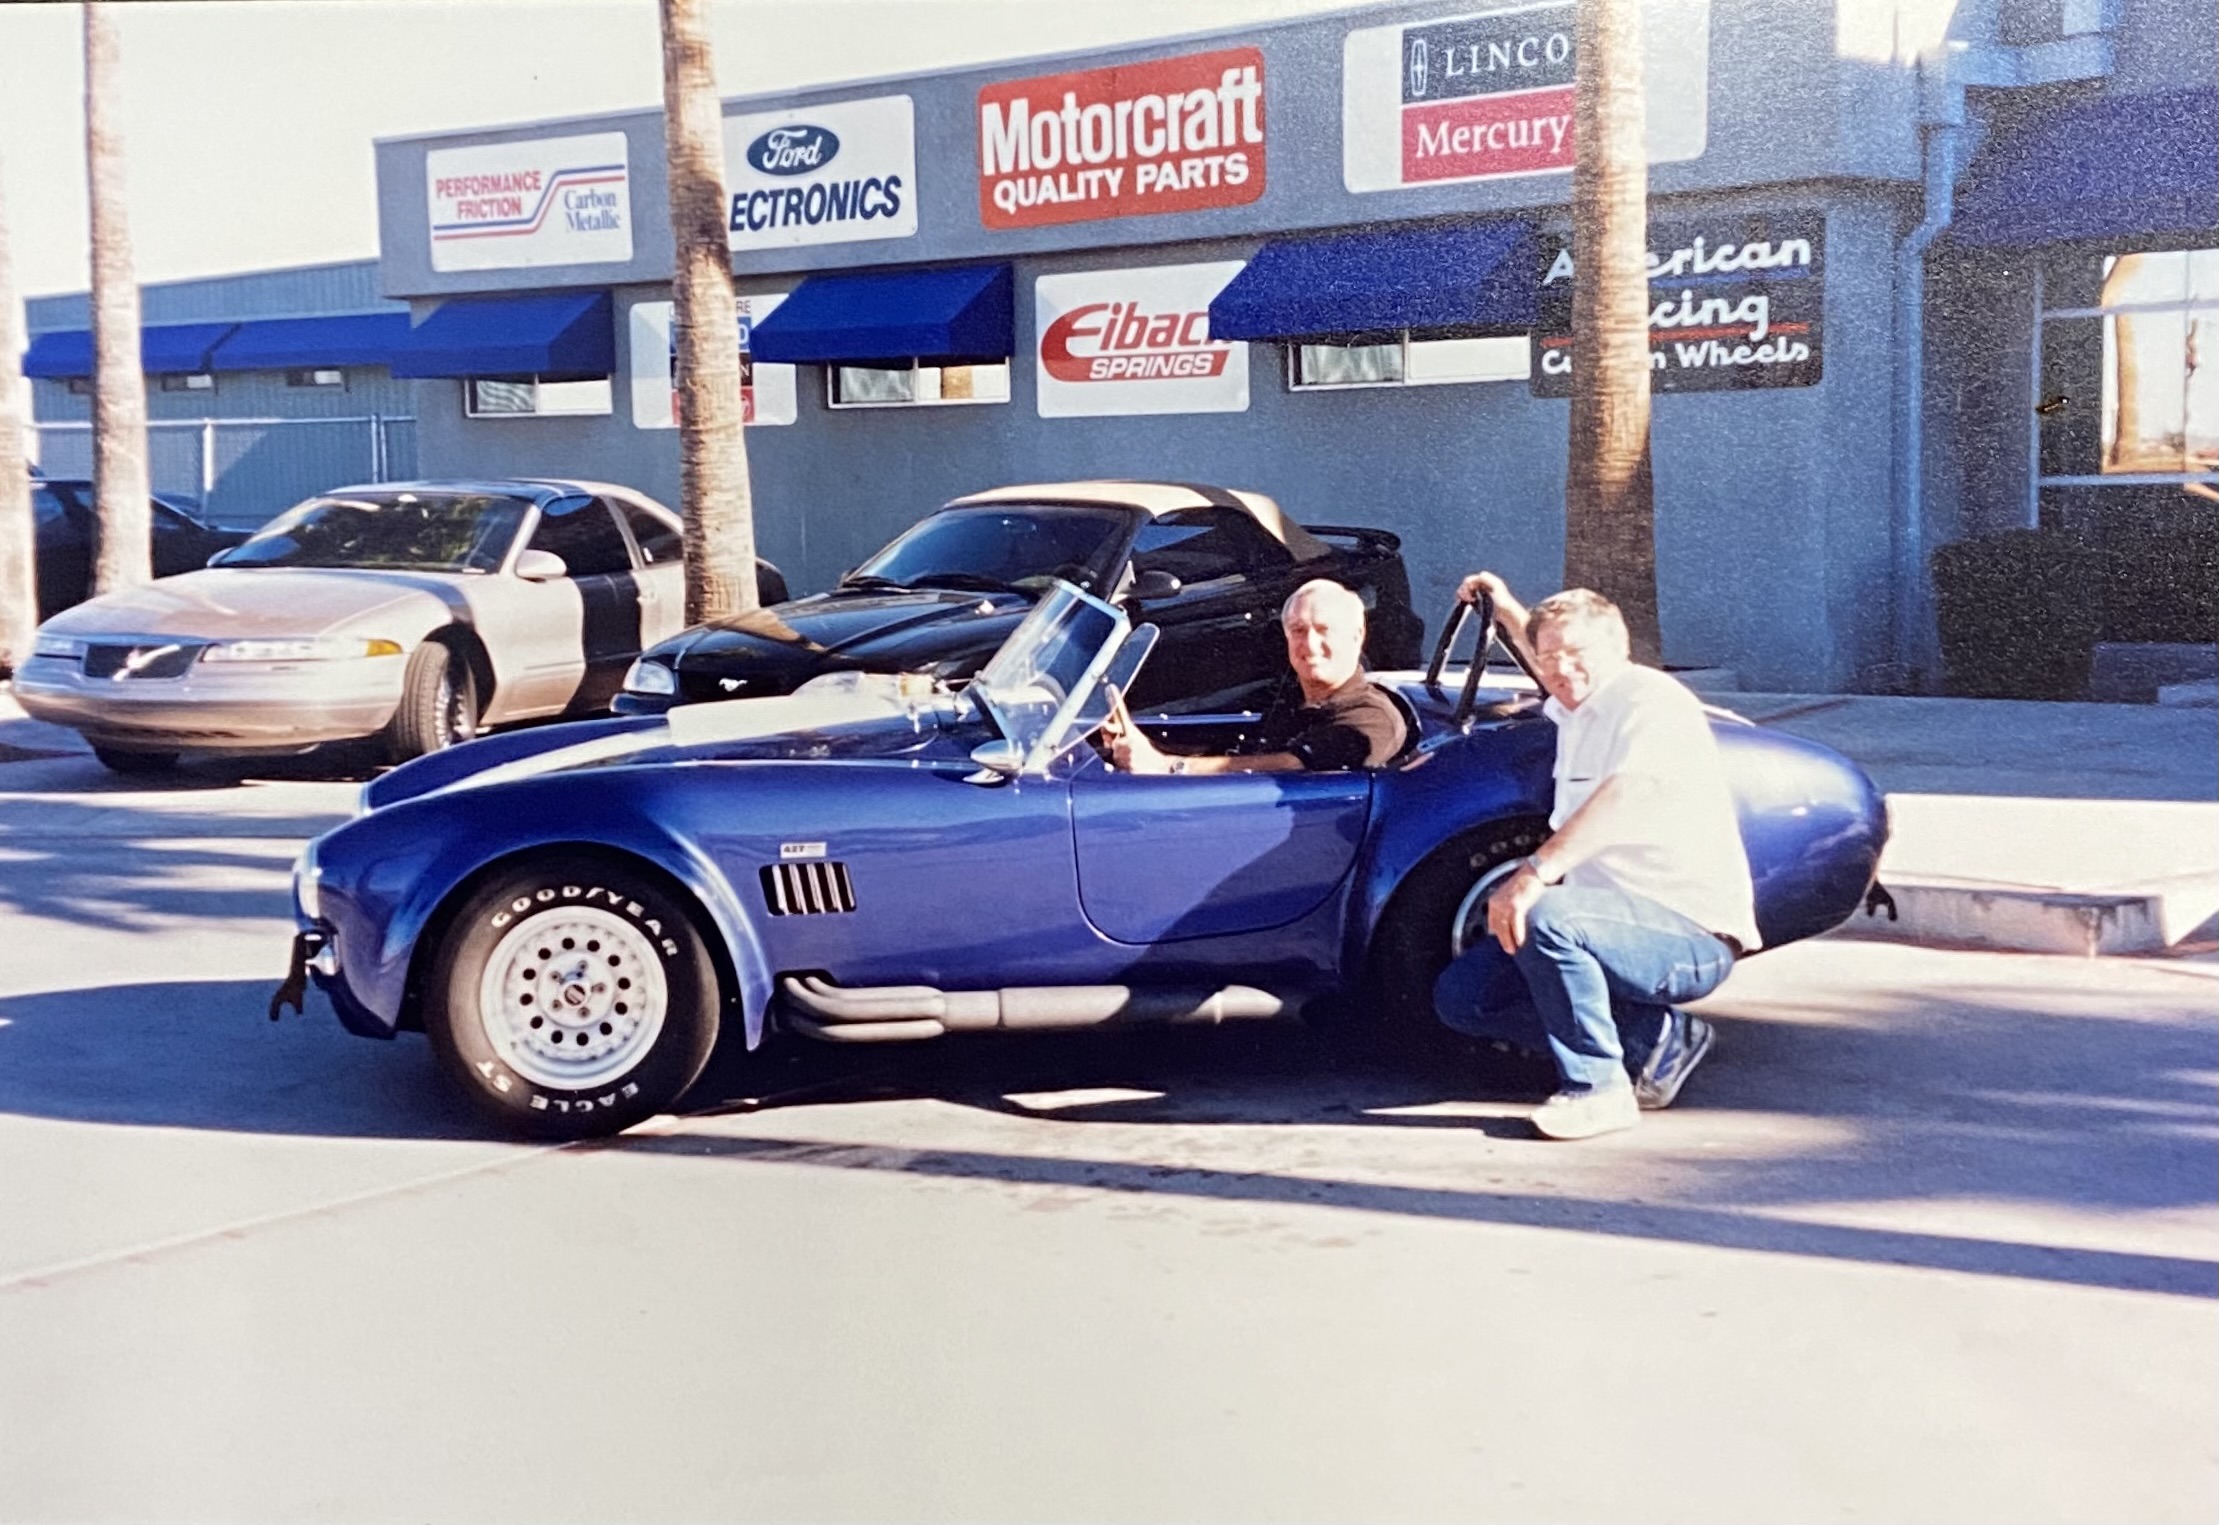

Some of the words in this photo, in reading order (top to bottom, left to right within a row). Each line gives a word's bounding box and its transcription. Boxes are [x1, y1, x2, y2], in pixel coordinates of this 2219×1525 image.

[1443, 32, 1569, 78] LINCO
[981, 66, 1263, 176] Motorcraft
[1416, 114, 1572, 158] Mercury
[762, 129, 823, 170] Ford
[436, 171, 542, 198] PERFORMANCE
[564, 188, 617, 211] Carbon
[730, 175, 902, 231] ECTRONICS
[993, 167, 1124, 215] QUALITY
[1136, 152, 1249, 195] PARTS
[457, 197, 522, 219] FRICTION
[565, 210, 620, 233] Metallic
[1542, 236, 1811, 286] Aerican
[1648, 289, 1769, 342] cing
[1041, 302, 1232, 376] Eibac
[1674, 336, 1809, 368] Wheels
[1089, 353, 1214, 380] SPRINGS
[491, 885, 678, 957] GOODYEAR
